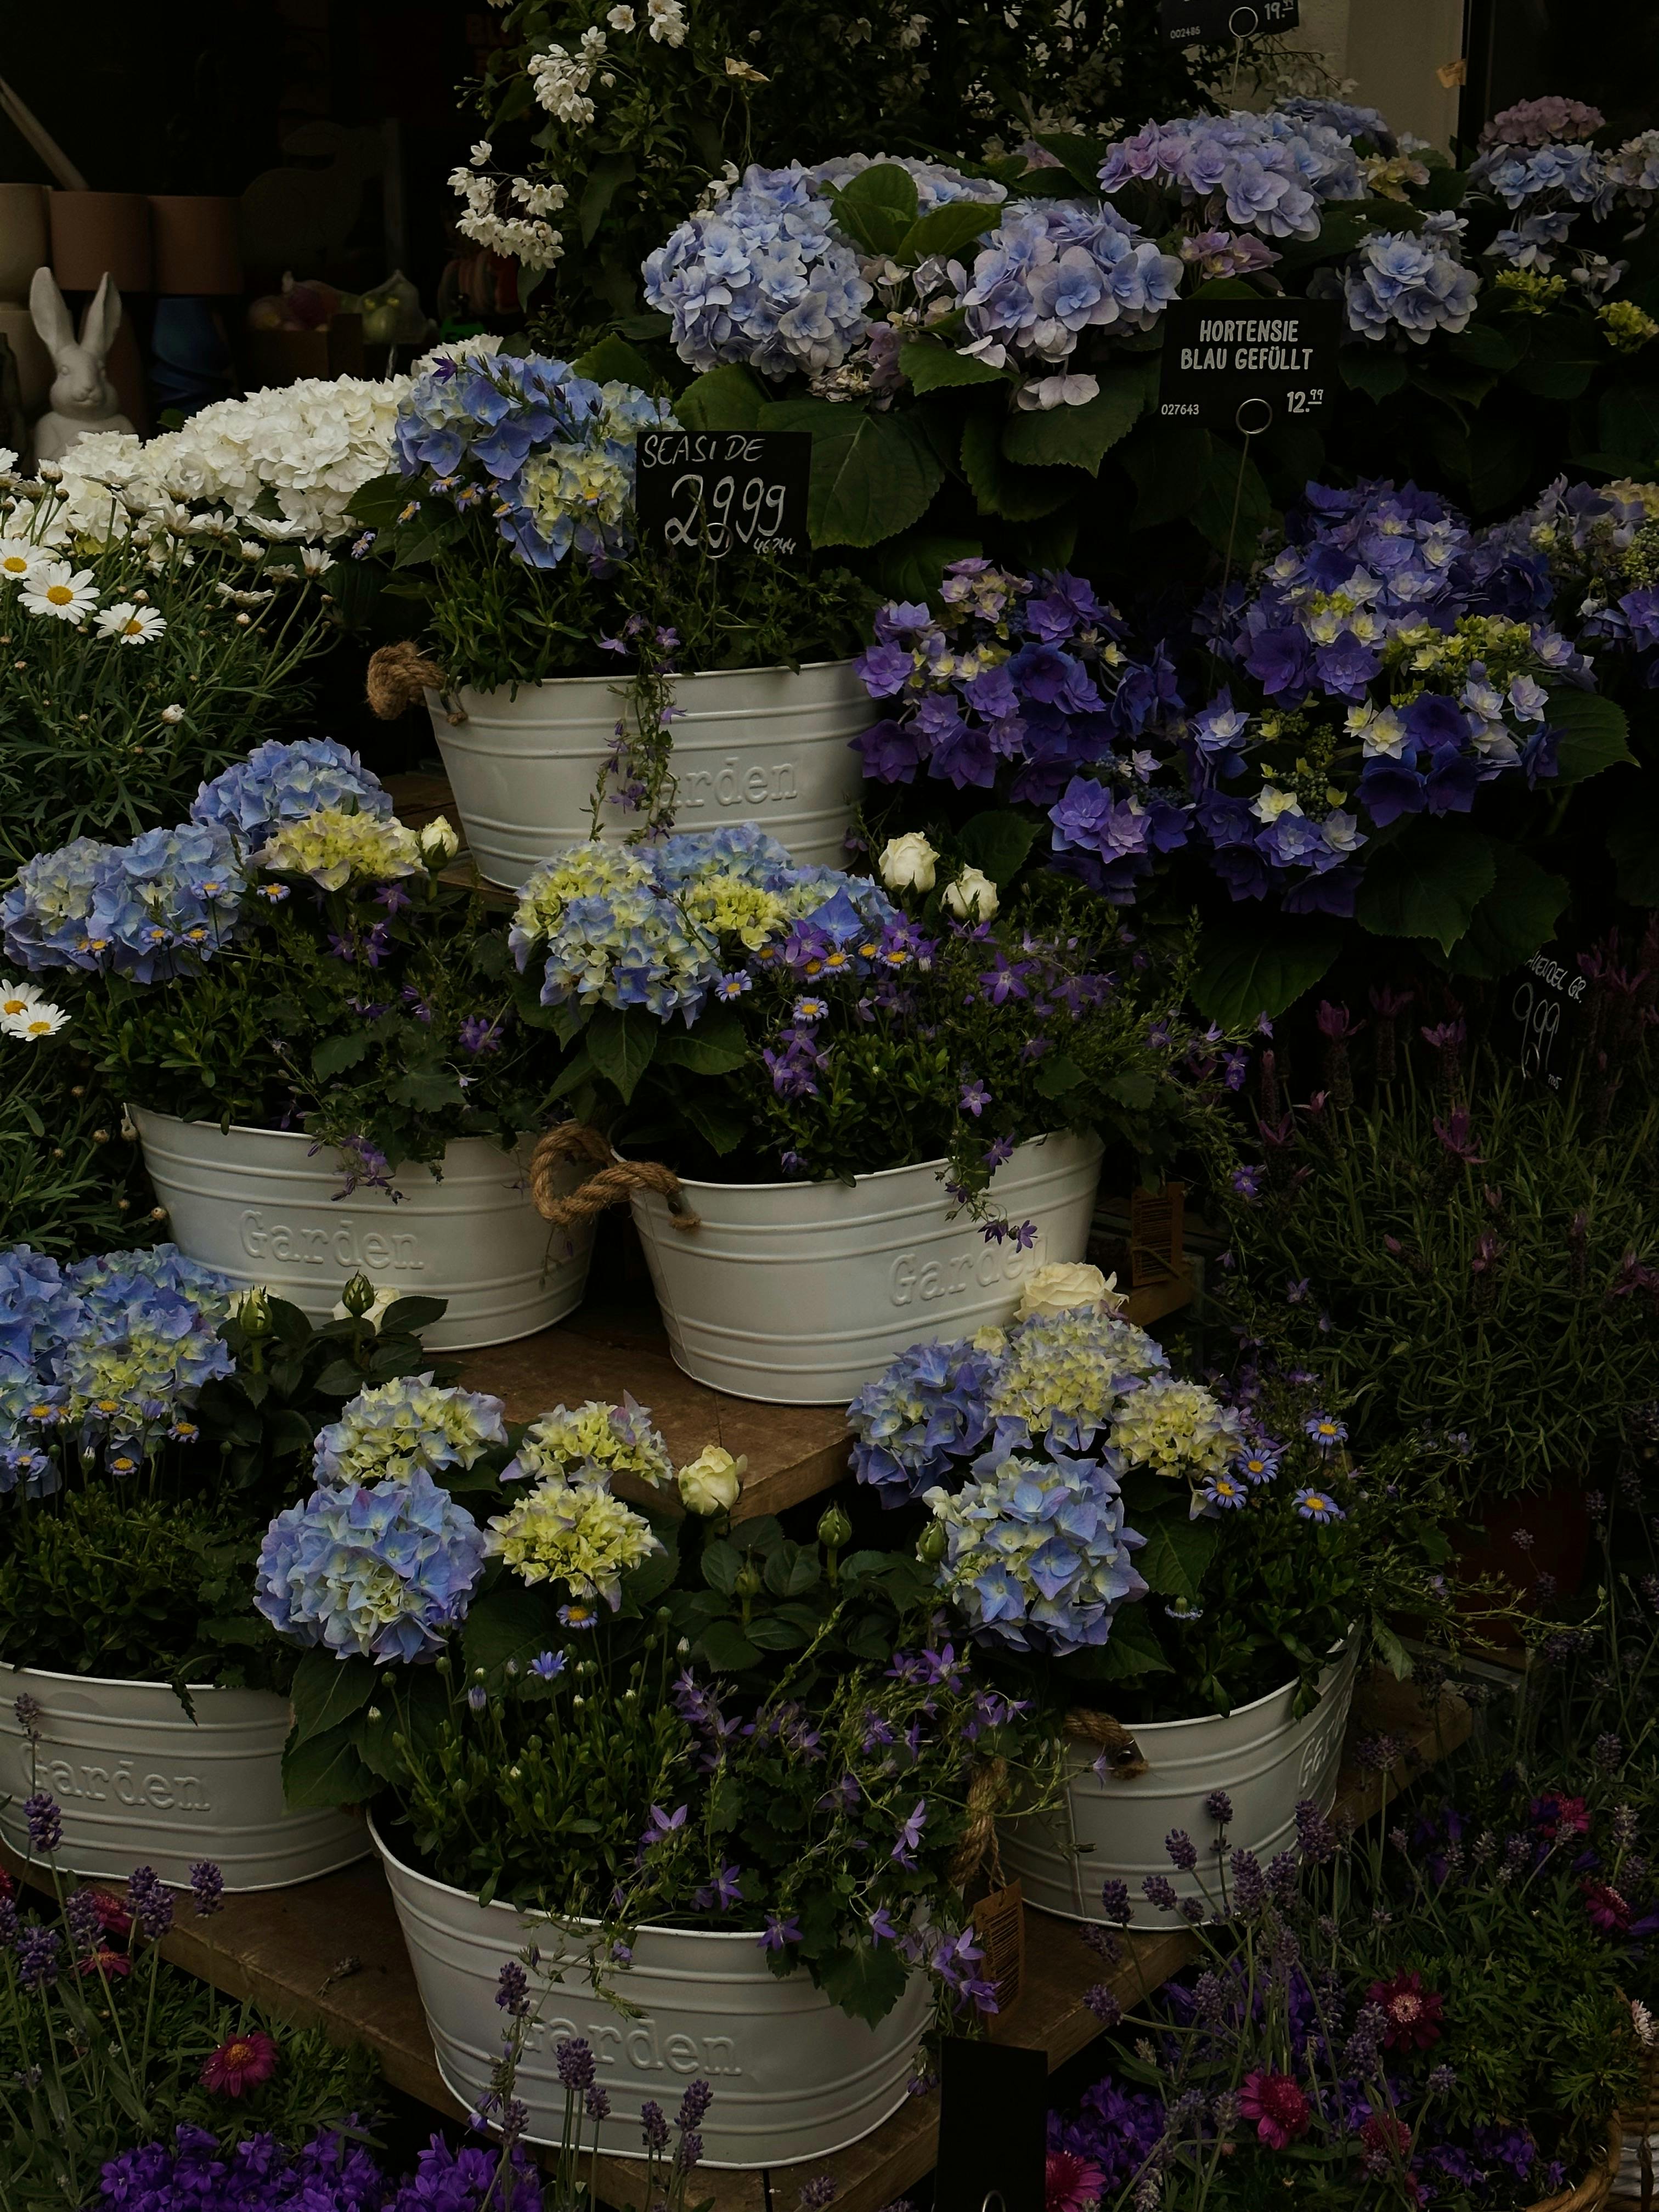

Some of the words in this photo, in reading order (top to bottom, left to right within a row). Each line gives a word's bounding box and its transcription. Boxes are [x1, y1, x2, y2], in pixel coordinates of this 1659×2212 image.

[1199, 319, 1299, 342] HORTENSIE
[1180, 348, 1227, 370] BLAU
[1235, 346, 1313, 370] GEFÜLLT
[1161, 404, 1199, 415] 027643
[1286, 389, 1324, 413] 12.99
[241, 1209, 425, 1269] Garden
[21, 1742, 211, 1811] Garden
